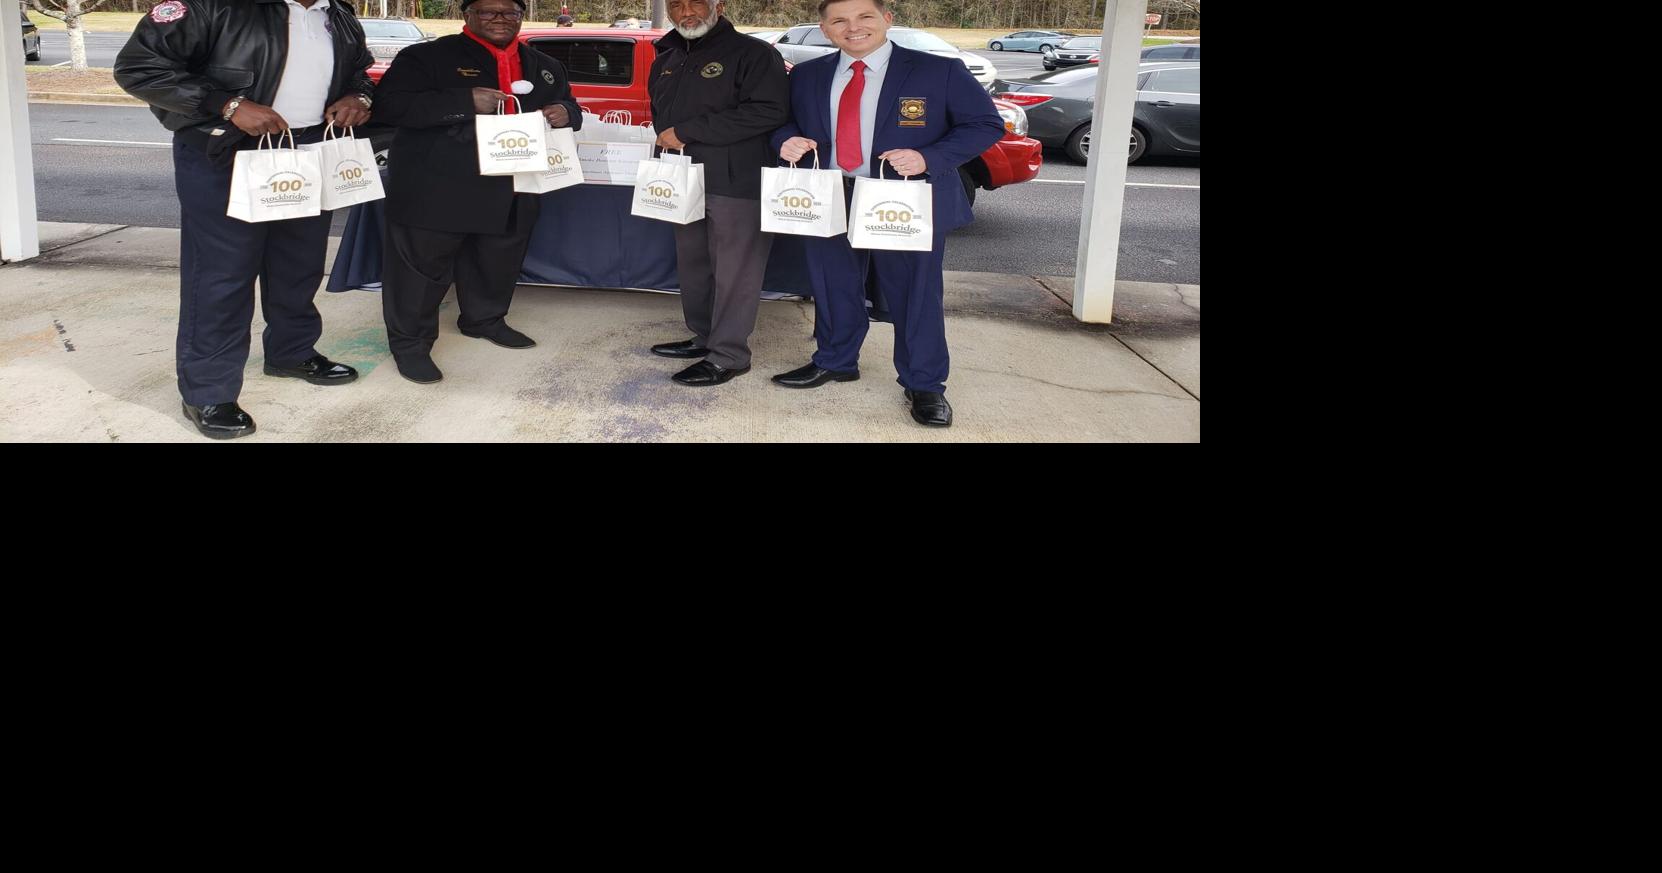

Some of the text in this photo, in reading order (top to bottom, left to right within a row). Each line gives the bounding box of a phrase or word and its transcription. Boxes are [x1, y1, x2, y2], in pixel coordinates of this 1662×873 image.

[497, 137, 528, 149] 100
[489, 148, 538, 159] Stockbridge
[547, 154, 563, 166] 00
[339, 167, 362, 181] 100
[270, 180, 303, 193] 100
[648, 186, 672, 198] 100
[260, 193, 310, 204] Stockbridge
[781, 195, 812, 208] 100
[772, 209, 822, 220] Stockbridge
[875, 210, 911, 223] 100
[865, 223, 921, 234] Stockbridge
